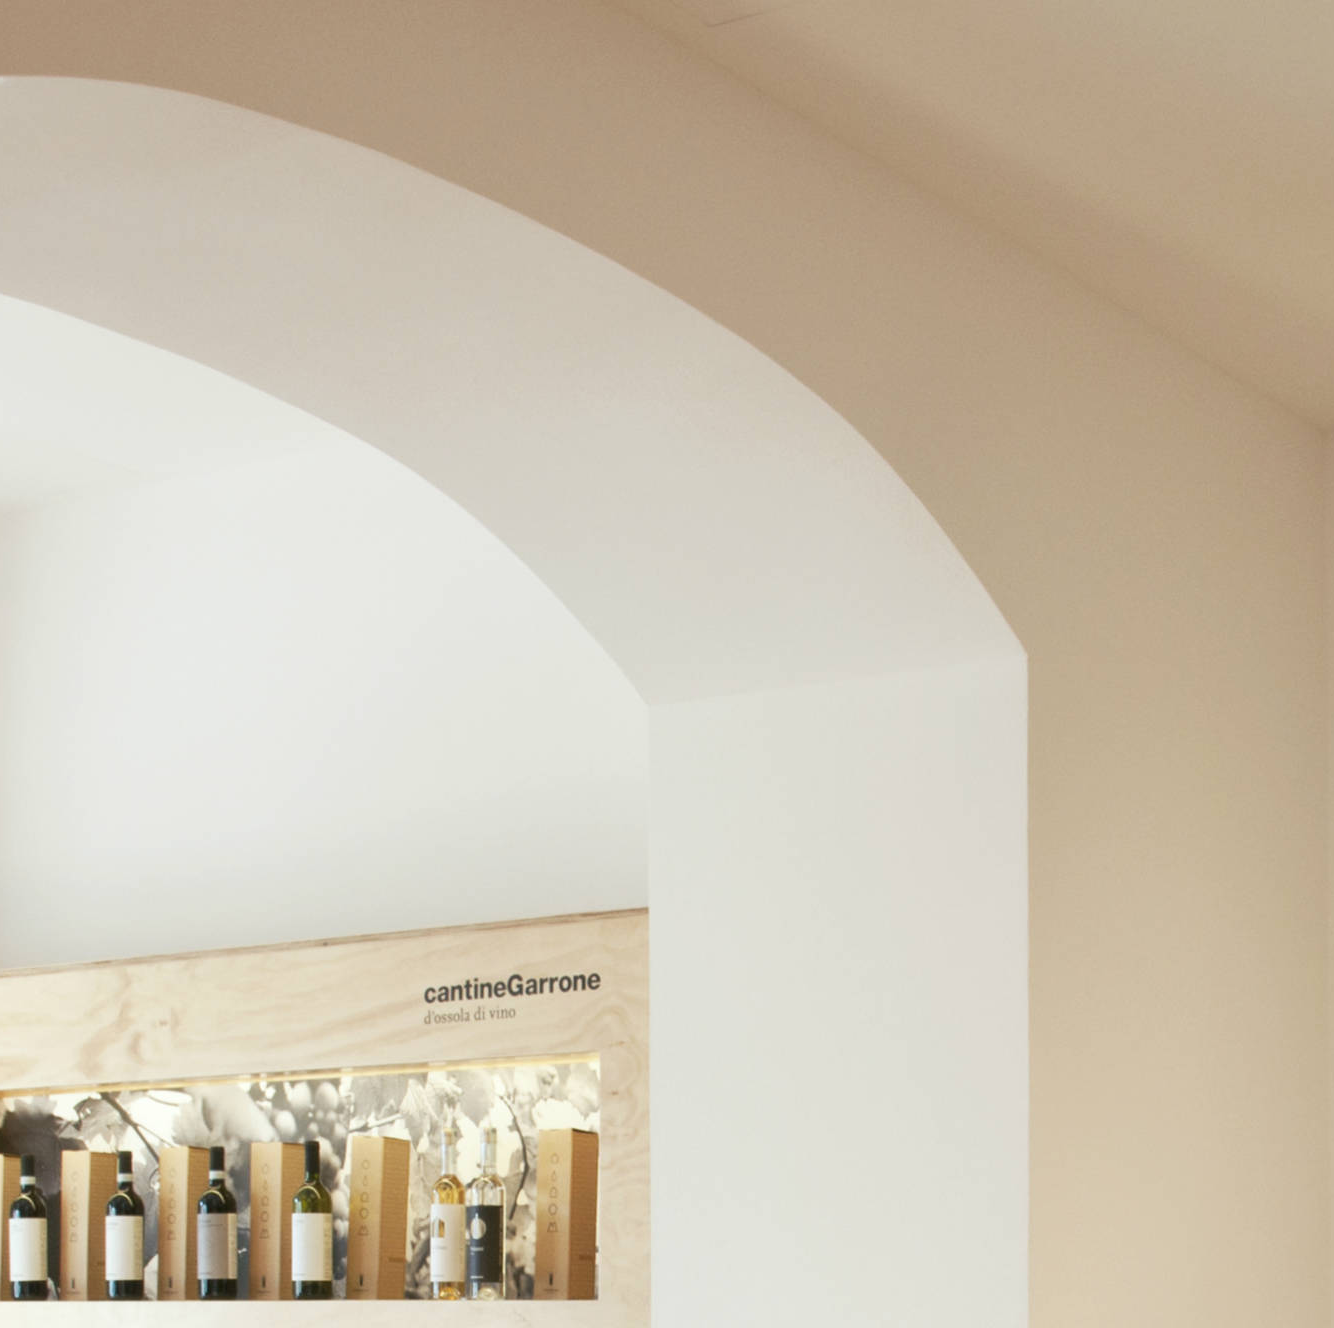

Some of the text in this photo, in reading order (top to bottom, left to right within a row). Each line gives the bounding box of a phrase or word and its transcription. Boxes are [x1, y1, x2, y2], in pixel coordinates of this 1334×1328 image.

[424, 973, 601, 1004] cantineGarrone
[474, 1006, 486, 1021] di
[489, 1006, 516, 1020] vino
